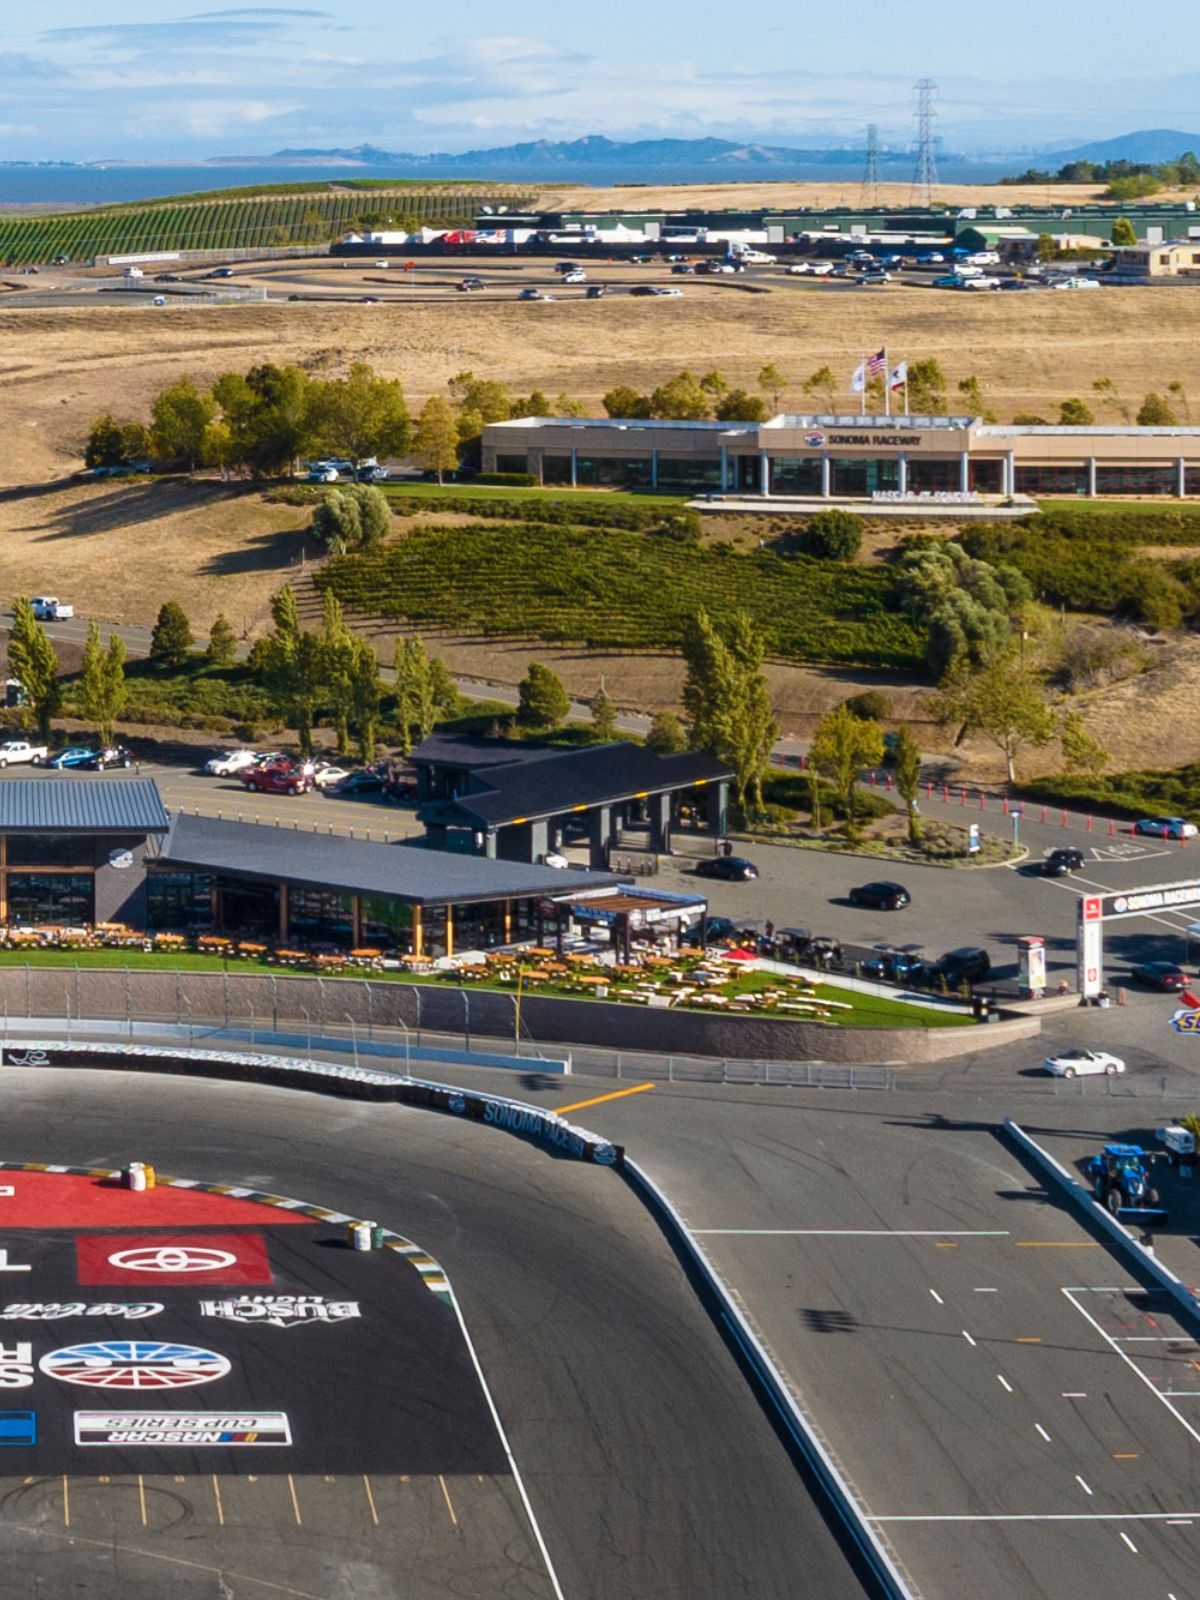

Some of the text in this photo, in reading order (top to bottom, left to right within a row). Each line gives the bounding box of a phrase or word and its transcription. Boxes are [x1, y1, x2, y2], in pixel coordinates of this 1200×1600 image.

[828, 434, 923, 446] SONOMA RACEWAY
[872, 490, 915, 502] NASCAR
[1127, 893, 1164, 910] SONOMA
[483, 1101, 542, 1136] SONOMA
[240, 1295, 324, 1303] LIGHT
[199, 1301, 362, 1318] BUSCH
[106, 1418, 258, 1428] CUP SERIES
[107, 1431, 222, 1442] NASCAR
